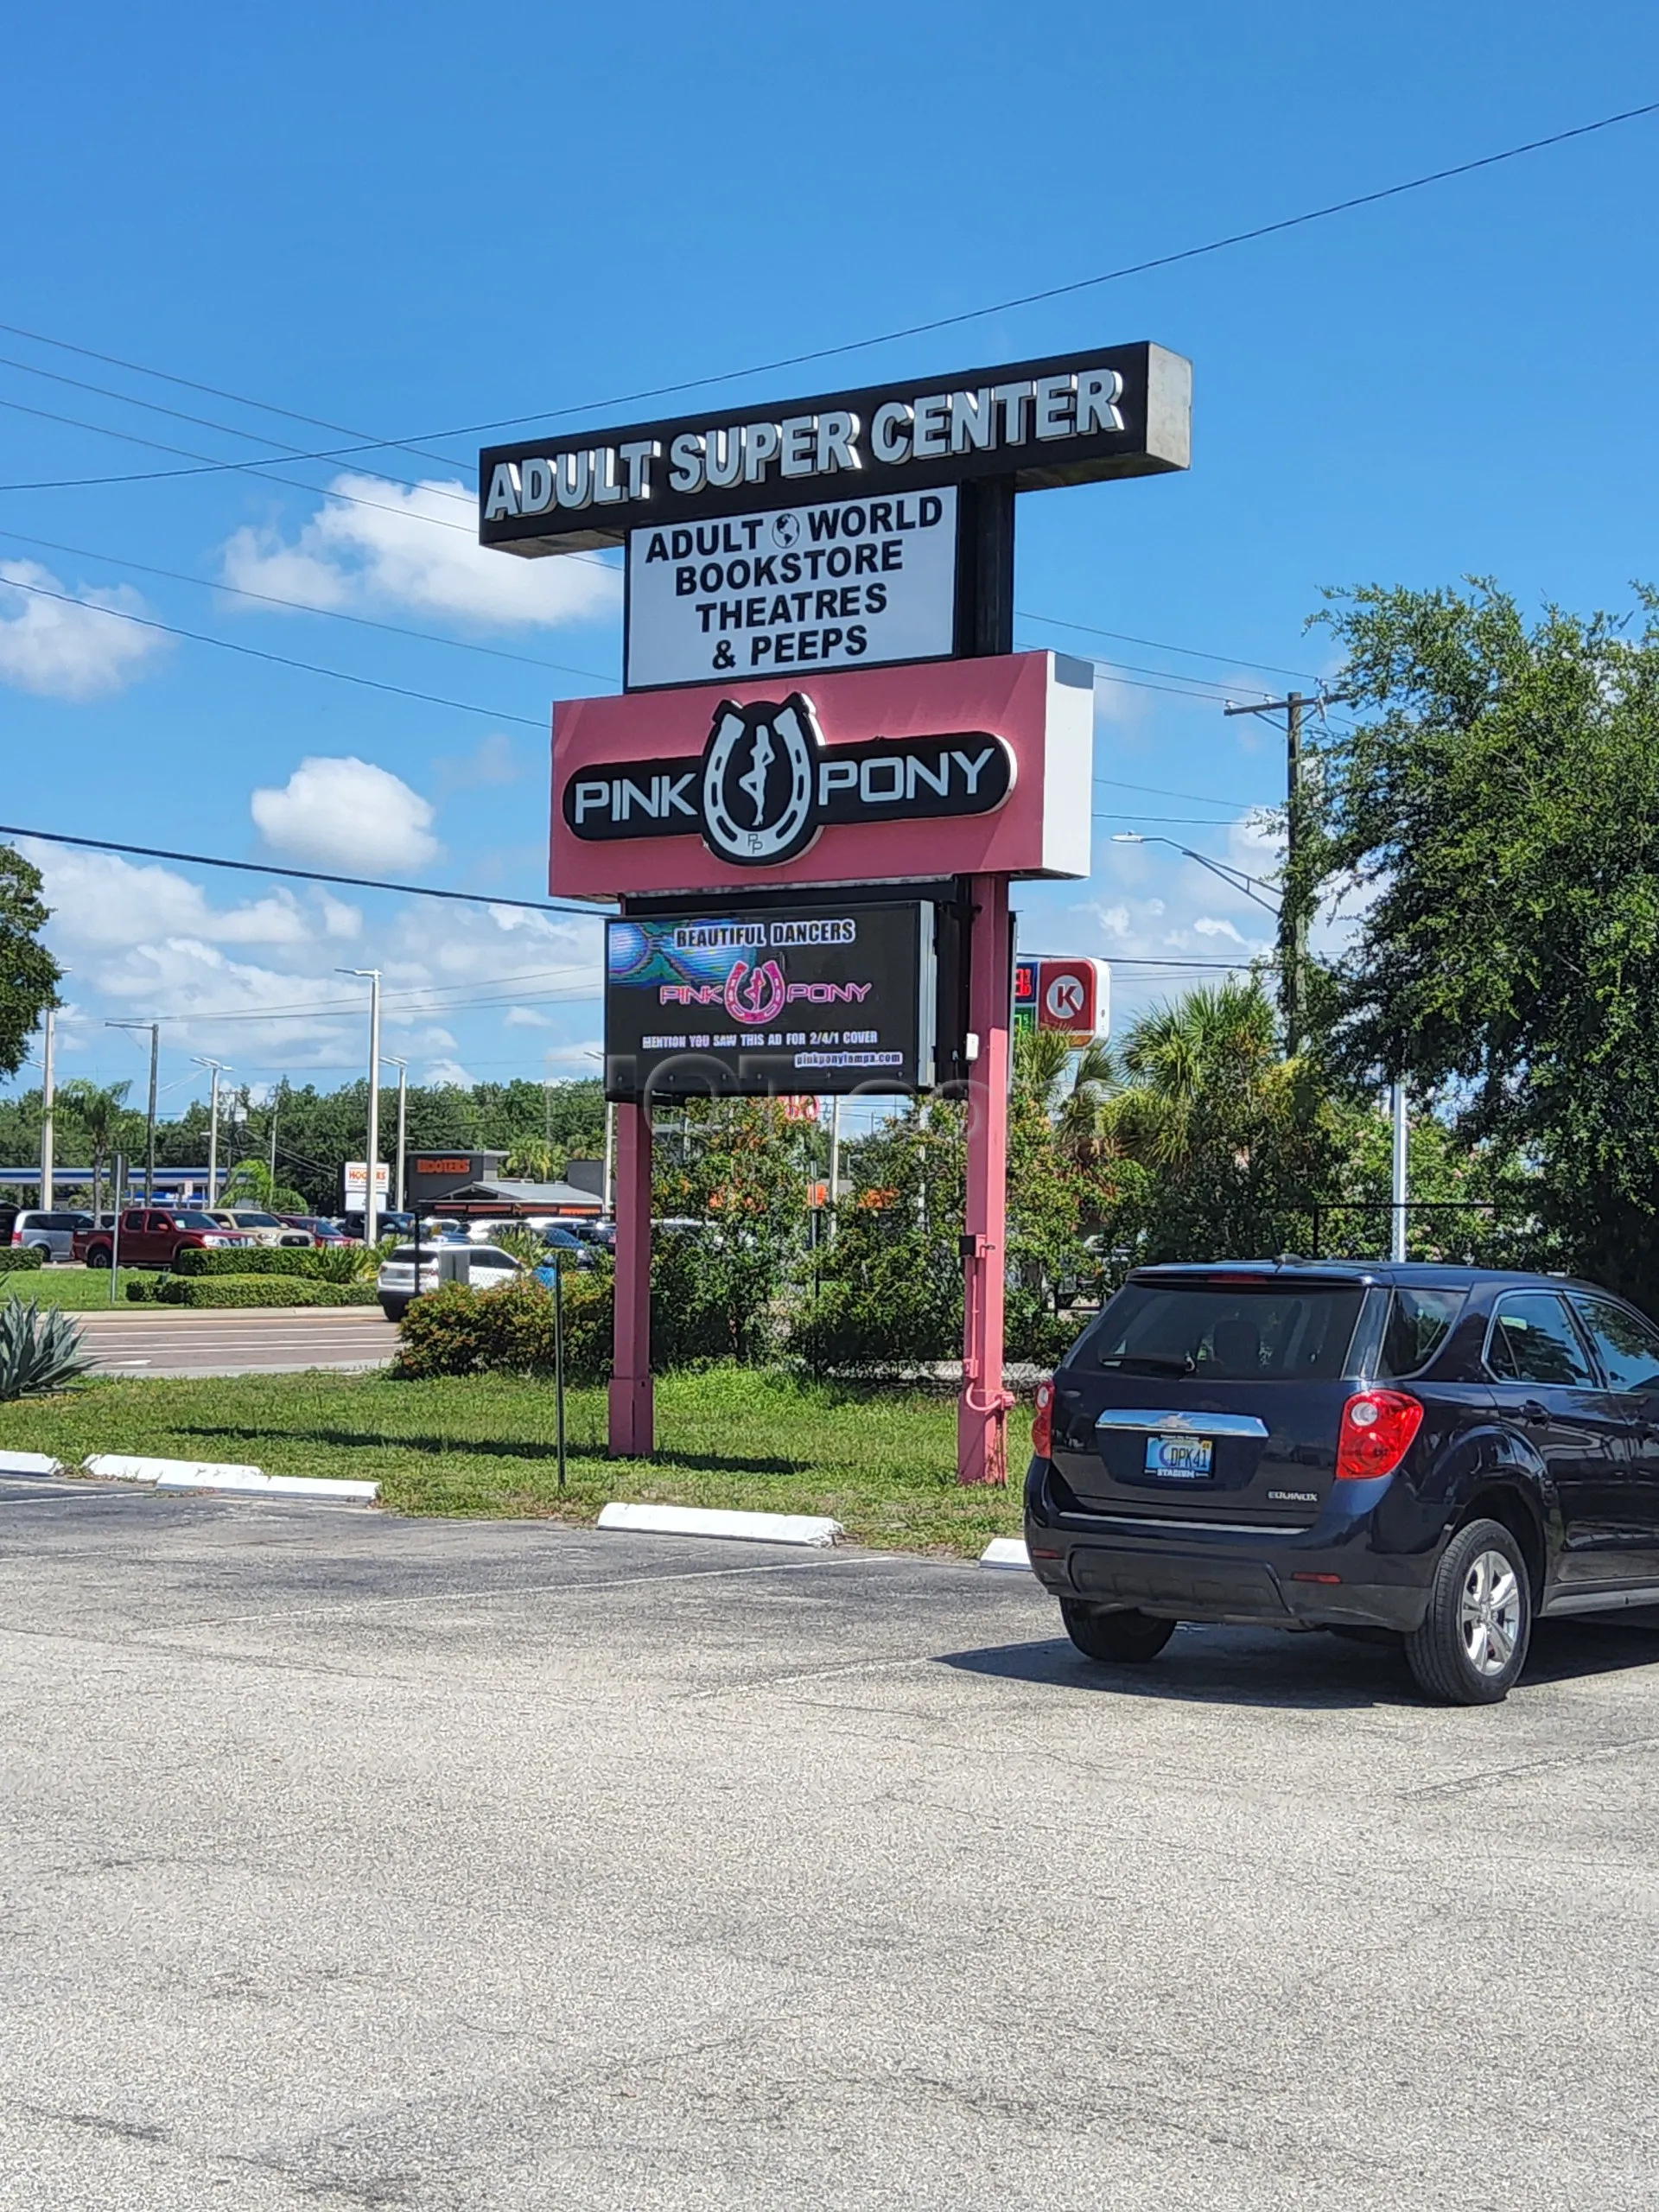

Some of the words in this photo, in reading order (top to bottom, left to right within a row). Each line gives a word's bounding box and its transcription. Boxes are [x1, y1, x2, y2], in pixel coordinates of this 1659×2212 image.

[485, 440, 660, 520] ADULT
[669, 410, 861, 493] SUPER
[872, 367, 1125, 465] CENTER
[645, 520, 764, 563] ADULT
[808, 495, 944, 541] WORLD
[676, 539, 904, 597] BOOKSTORE
[696, 582, 887, 633] THEATRES
[711, 640, 736, 671] &
[751, 625, 868, 669] PEEPS
[575, 772, 698, 824] PINK
[818, 747, 995, 805] PONY
[676, 924, 766, 949] BEAUTIFUL
[772, 920, 855, 944] DANCERS
[659, 984, 723, 1005] PINK
[787, 982, 873, 1003] PONY
[642, 1036, 686, 1049] MENTION
[690, 1035, 710, 1048] YOU
[713, 1035, 737, 1047] SAW
[741, 1034, 765, 1046] THIS
[768, 1033, 782, 1046] AD
[785, 1033, 805, 1046] FOR
[810, 1033, 840, 1045] 2/4/1
[842, 1031, 878, 1044] COVER
[349, 1170, 386, 1180] HOORS
[416, 1159, 471, 1173] HOOTERS
[1268, 1491, 1318, 1502] EQUINOX
